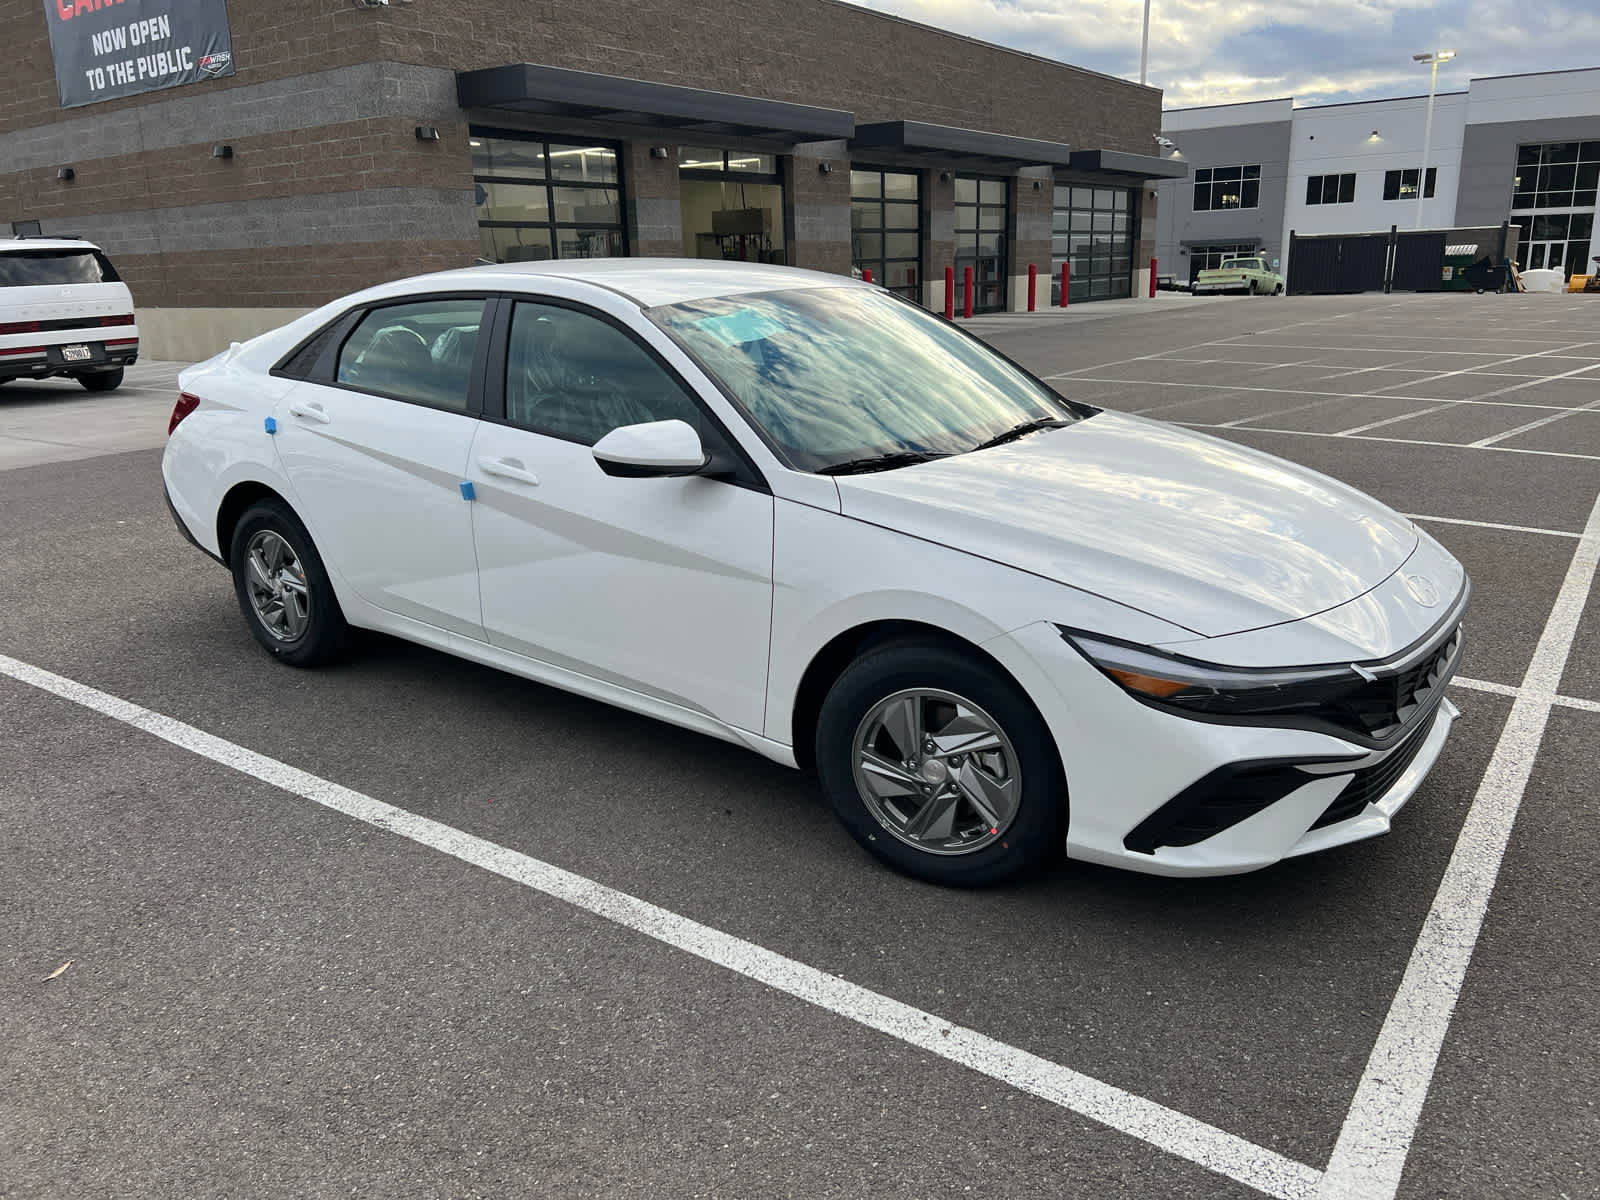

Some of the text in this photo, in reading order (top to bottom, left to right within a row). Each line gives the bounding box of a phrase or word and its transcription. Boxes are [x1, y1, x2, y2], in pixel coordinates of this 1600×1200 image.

[91, 14, 171, 57] NOW OPEN
[86, 67, 106, 91] TO
[106, 60, 136, 87] THE
[137, 46, 194, 80] PUBLIC
